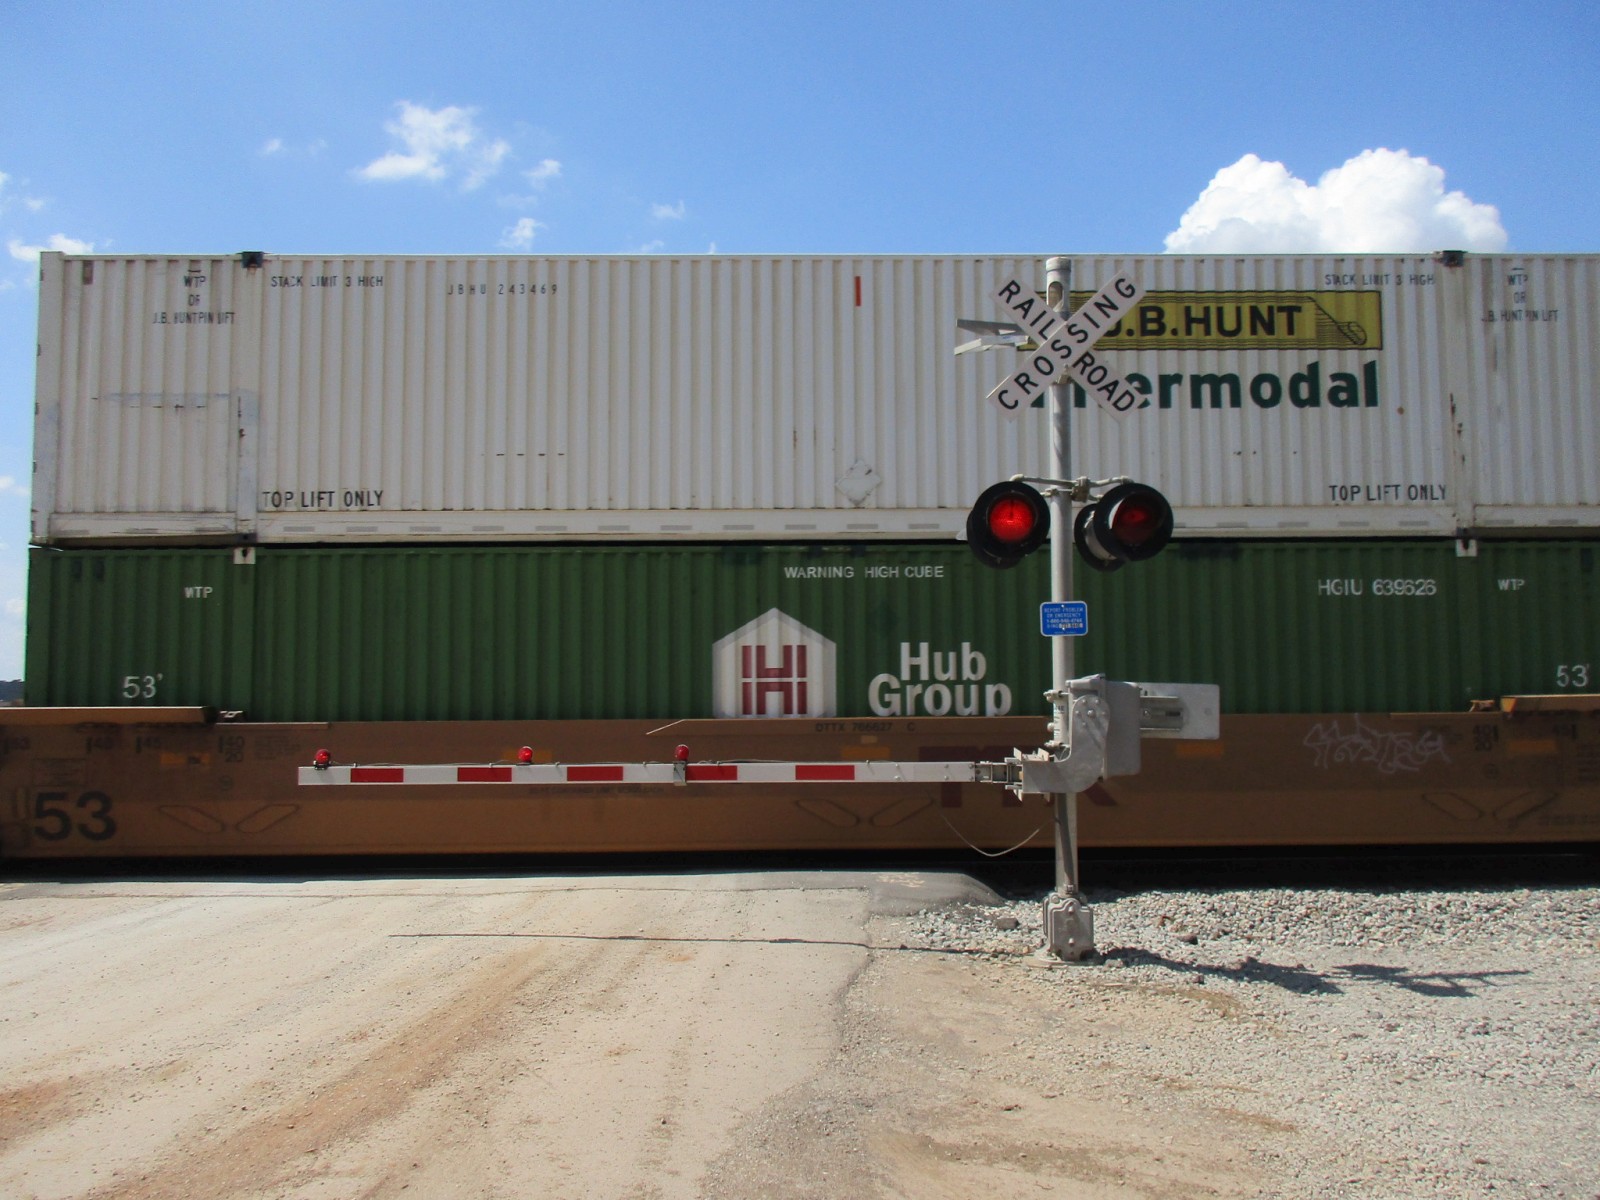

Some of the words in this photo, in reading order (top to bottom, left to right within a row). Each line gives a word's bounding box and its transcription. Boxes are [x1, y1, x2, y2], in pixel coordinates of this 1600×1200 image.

[183, 275, 207, 288] WTP
[271, 275, 304, 287] STACK
[345, 275, 353, 287] 3
[358, 275, 384, 287] HIGH
[1324, 274, 1357, 286] STACK
[1362, 274, 1391, 286] LIMIT
[1395, 274, 1403, 286] 3
[1409, 274, 1435, 286] HIGH
[997, 277, 1136, 410] CROSSING
[998, 279, 1056, 341] RAIL
[1071, 351, 1135, 412] ROAD
[262, 490, 295, 508] TOP
[301, 490, 336, 508] LIFT
[343, 490, 384, 508] ONLY
[1328, 484, 1362, 501] TOP
[1366, 484, 1401, 501] LIFT
[1407, 484, 1447, 501] ONLY
[784, 566, 855, 579] WARNING
[864, 566, 900, 579] HIGH
[904, 566, 945, 579] CUBE
[183, 586, 214, 599] WTP
[1317, 578, 1363, 597] HGIU
[1371, 578, 1437, 597] 639626
[1497, 578, 1526, 592] WTP
[900, 641, 987, 681] Hub
[868, 673, 1013, 717] Group
[34, 789, 117, 841] 53
